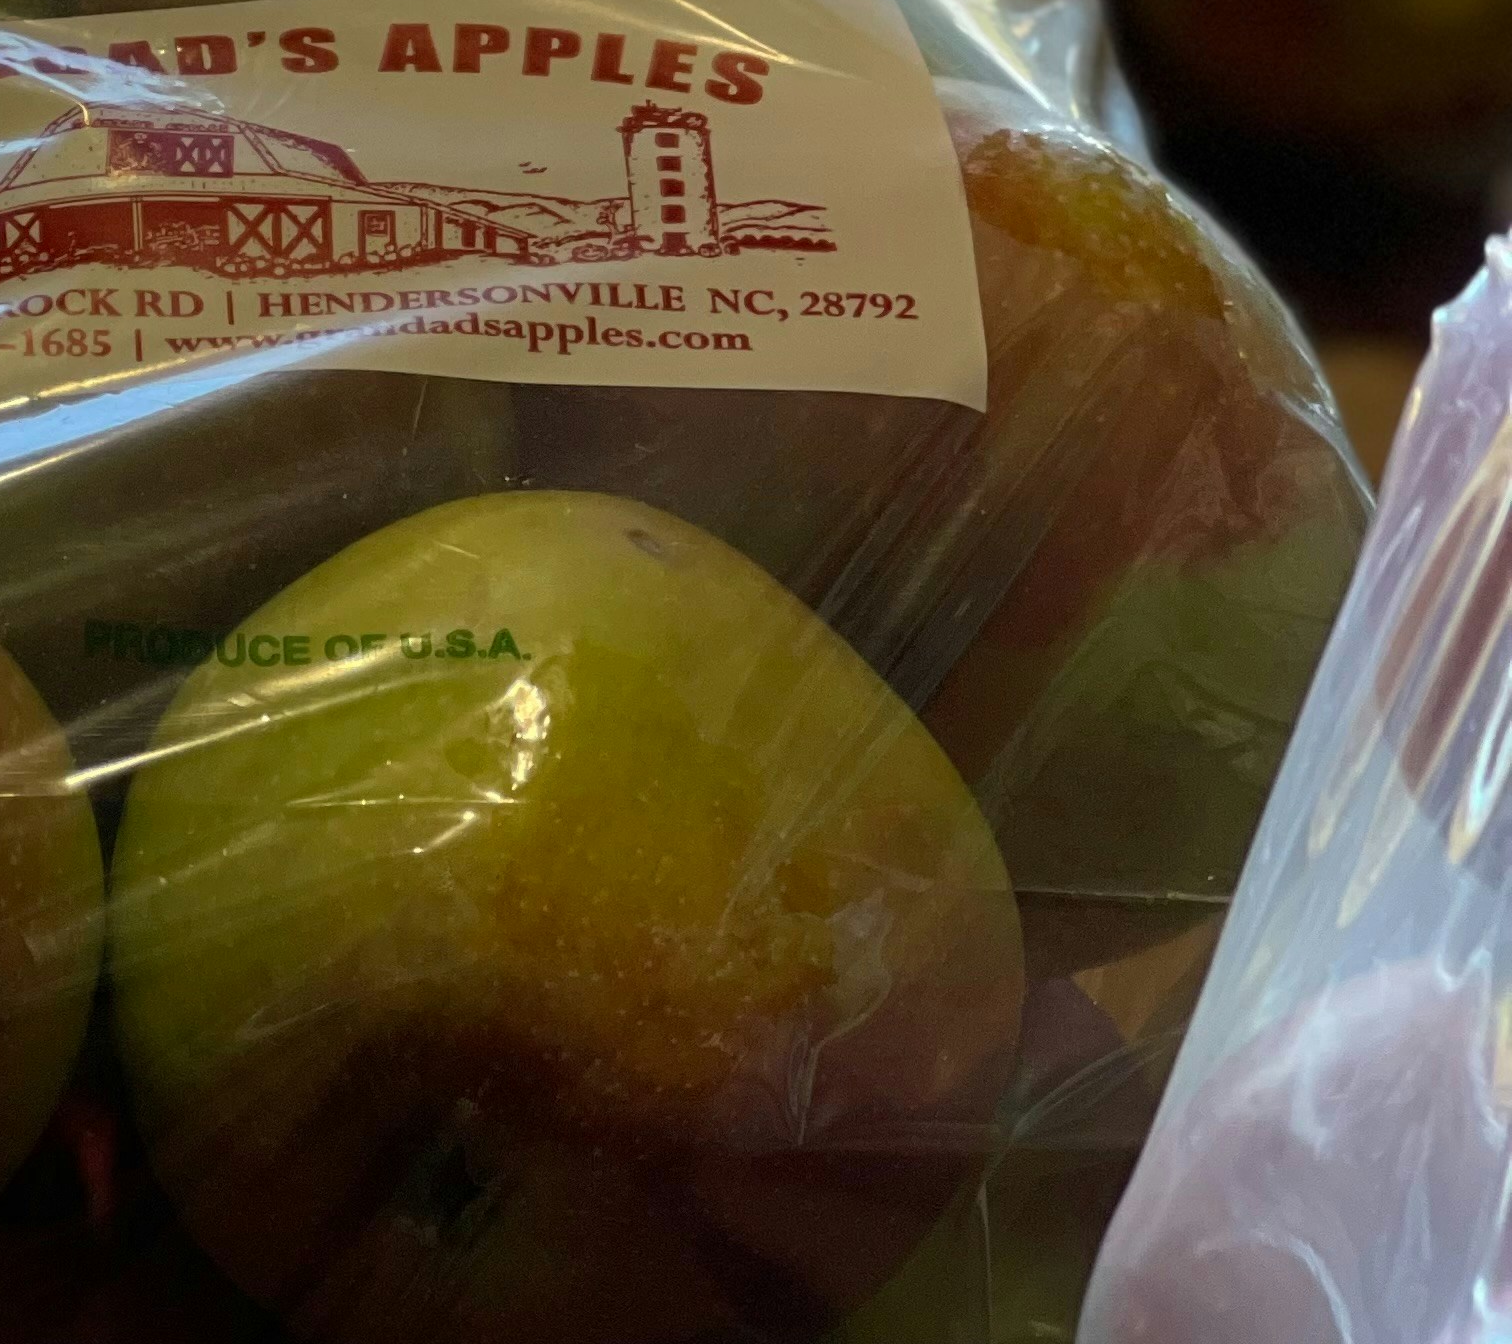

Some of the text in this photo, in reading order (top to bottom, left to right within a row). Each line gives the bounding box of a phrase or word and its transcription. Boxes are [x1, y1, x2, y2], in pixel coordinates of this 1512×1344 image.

[377, 22, 771, 106] APPLES
[135, 290, 205, 318] RD
[257, 282, 686, 318] HENDERSONVILLE
[705, 287, 789, 323] NC,
[799, 290, 920, 321] 28792
[84, 618, 311, 668] PRODUCE
[399, 627, 533, 663] U.S.A.
